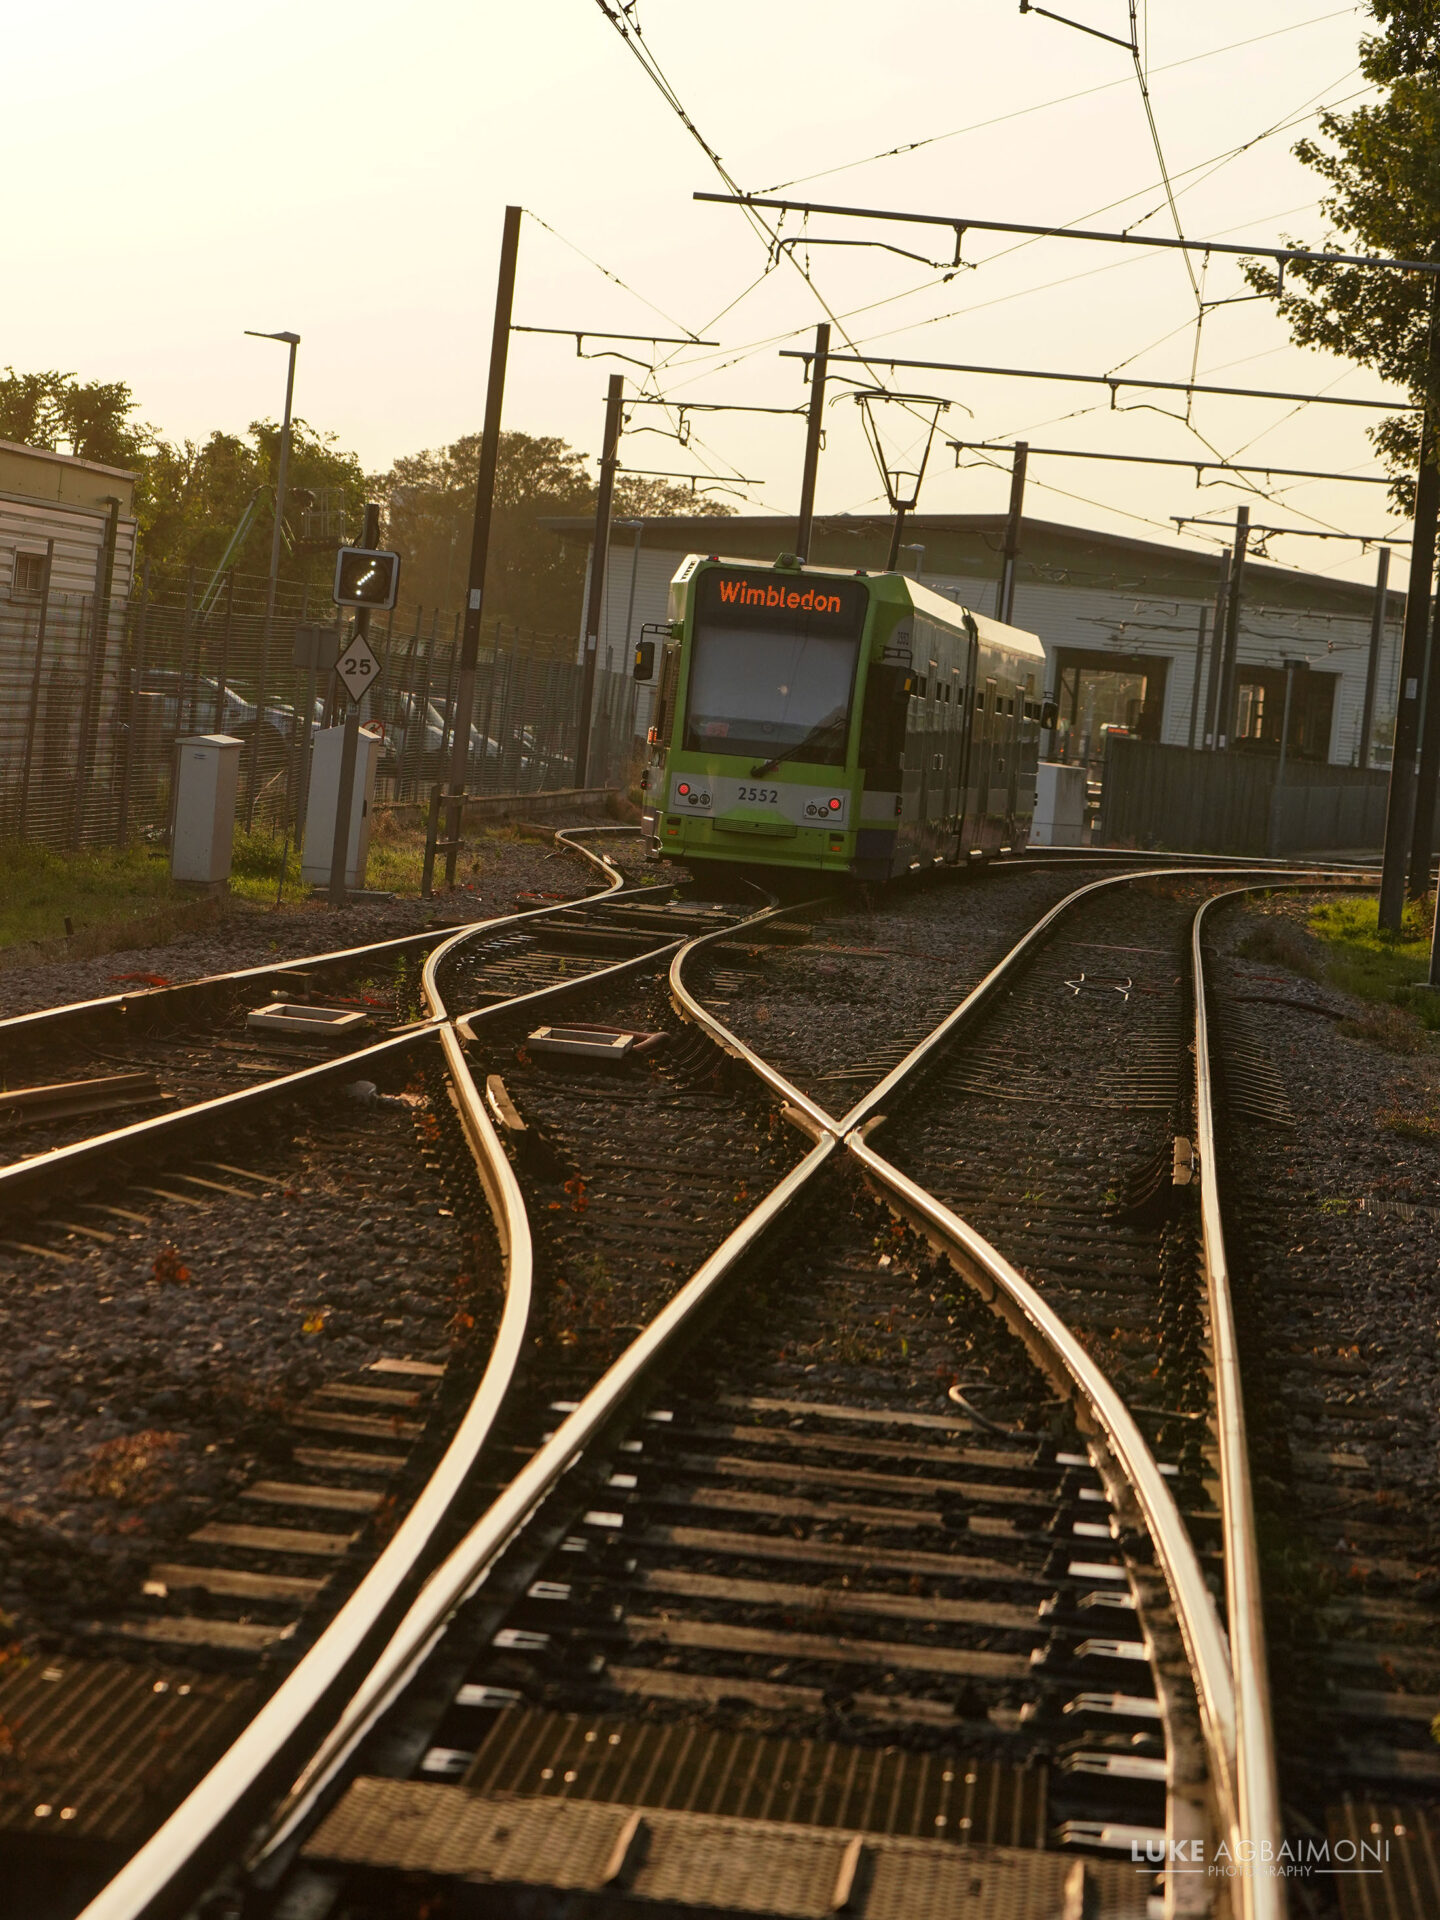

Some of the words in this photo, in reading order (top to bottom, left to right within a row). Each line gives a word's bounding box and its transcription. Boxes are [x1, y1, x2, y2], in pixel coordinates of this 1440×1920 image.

[719, 580, 841, 613] Wimbledon
[345, 659, 371, 675] 25
[738, 786, 778, 804] 2552
